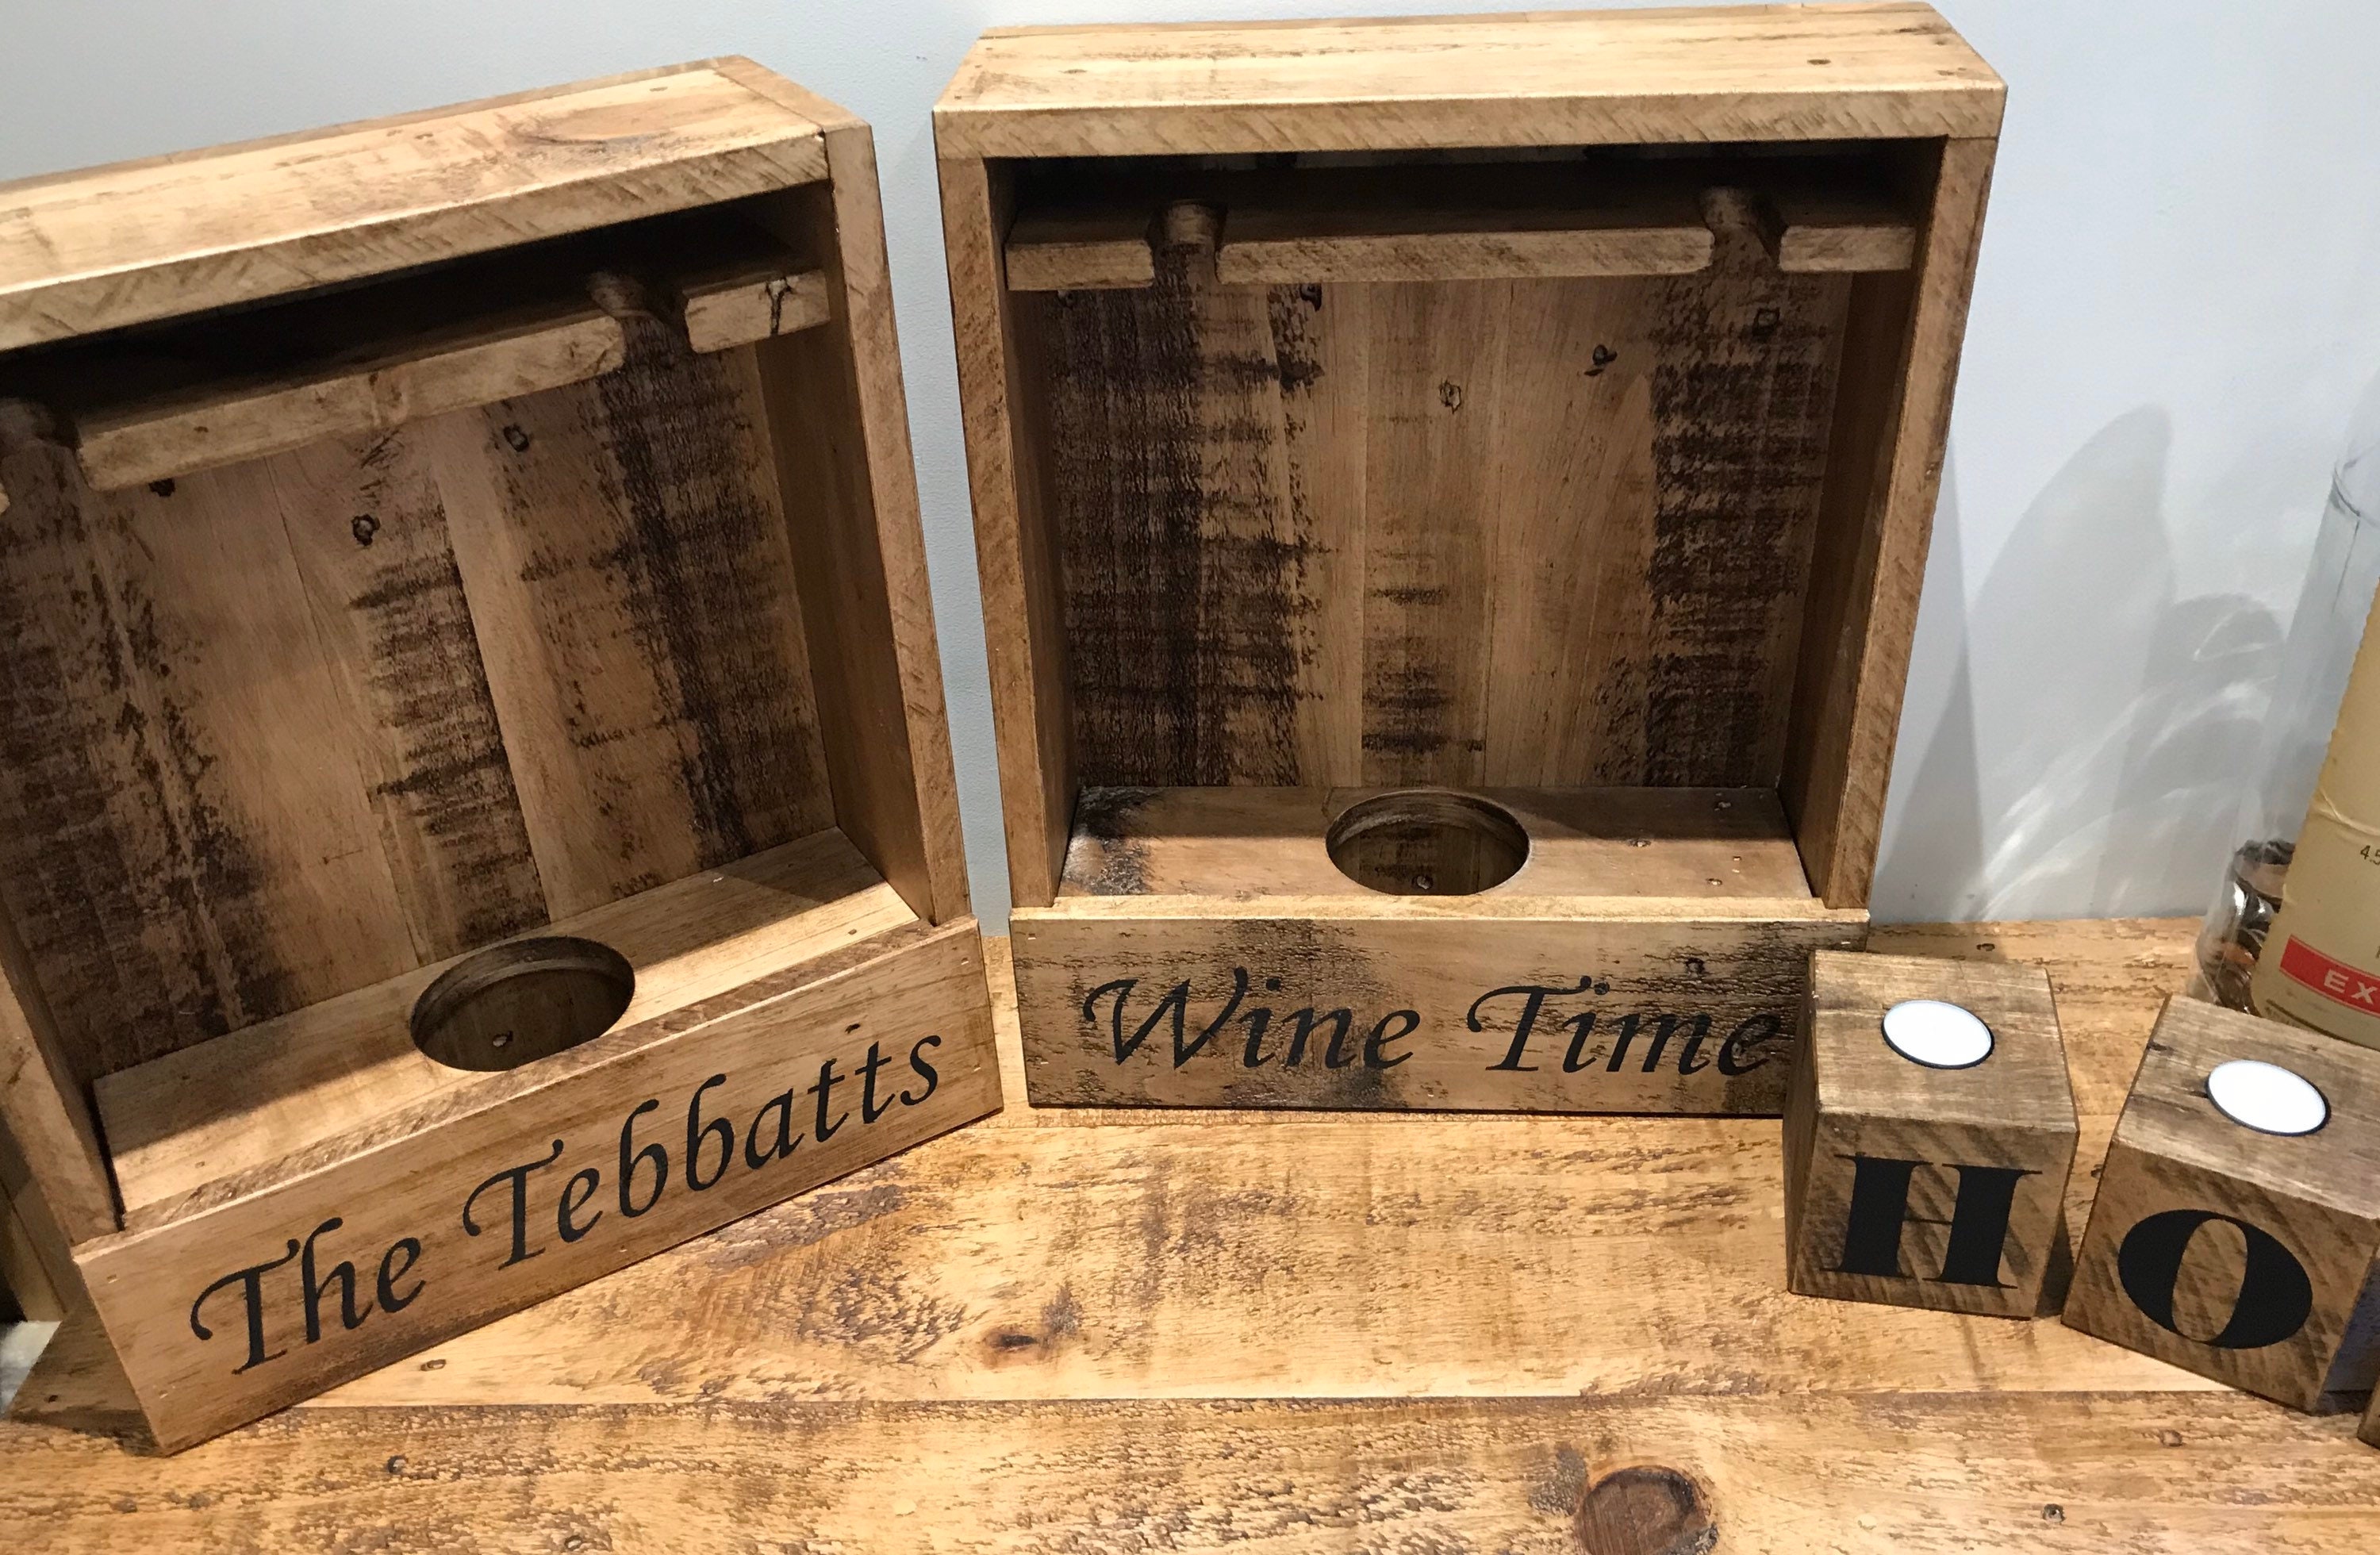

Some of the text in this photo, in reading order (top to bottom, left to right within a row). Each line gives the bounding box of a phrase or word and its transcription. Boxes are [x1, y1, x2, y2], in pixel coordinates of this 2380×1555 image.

[1082, 966, 1783, 1077] Wine Time
[189, 1034, 944, 1375] The Tebbatts
[1818, 1153, 2044, 1290] H
[2117, 1209, 2313, 1350] O
